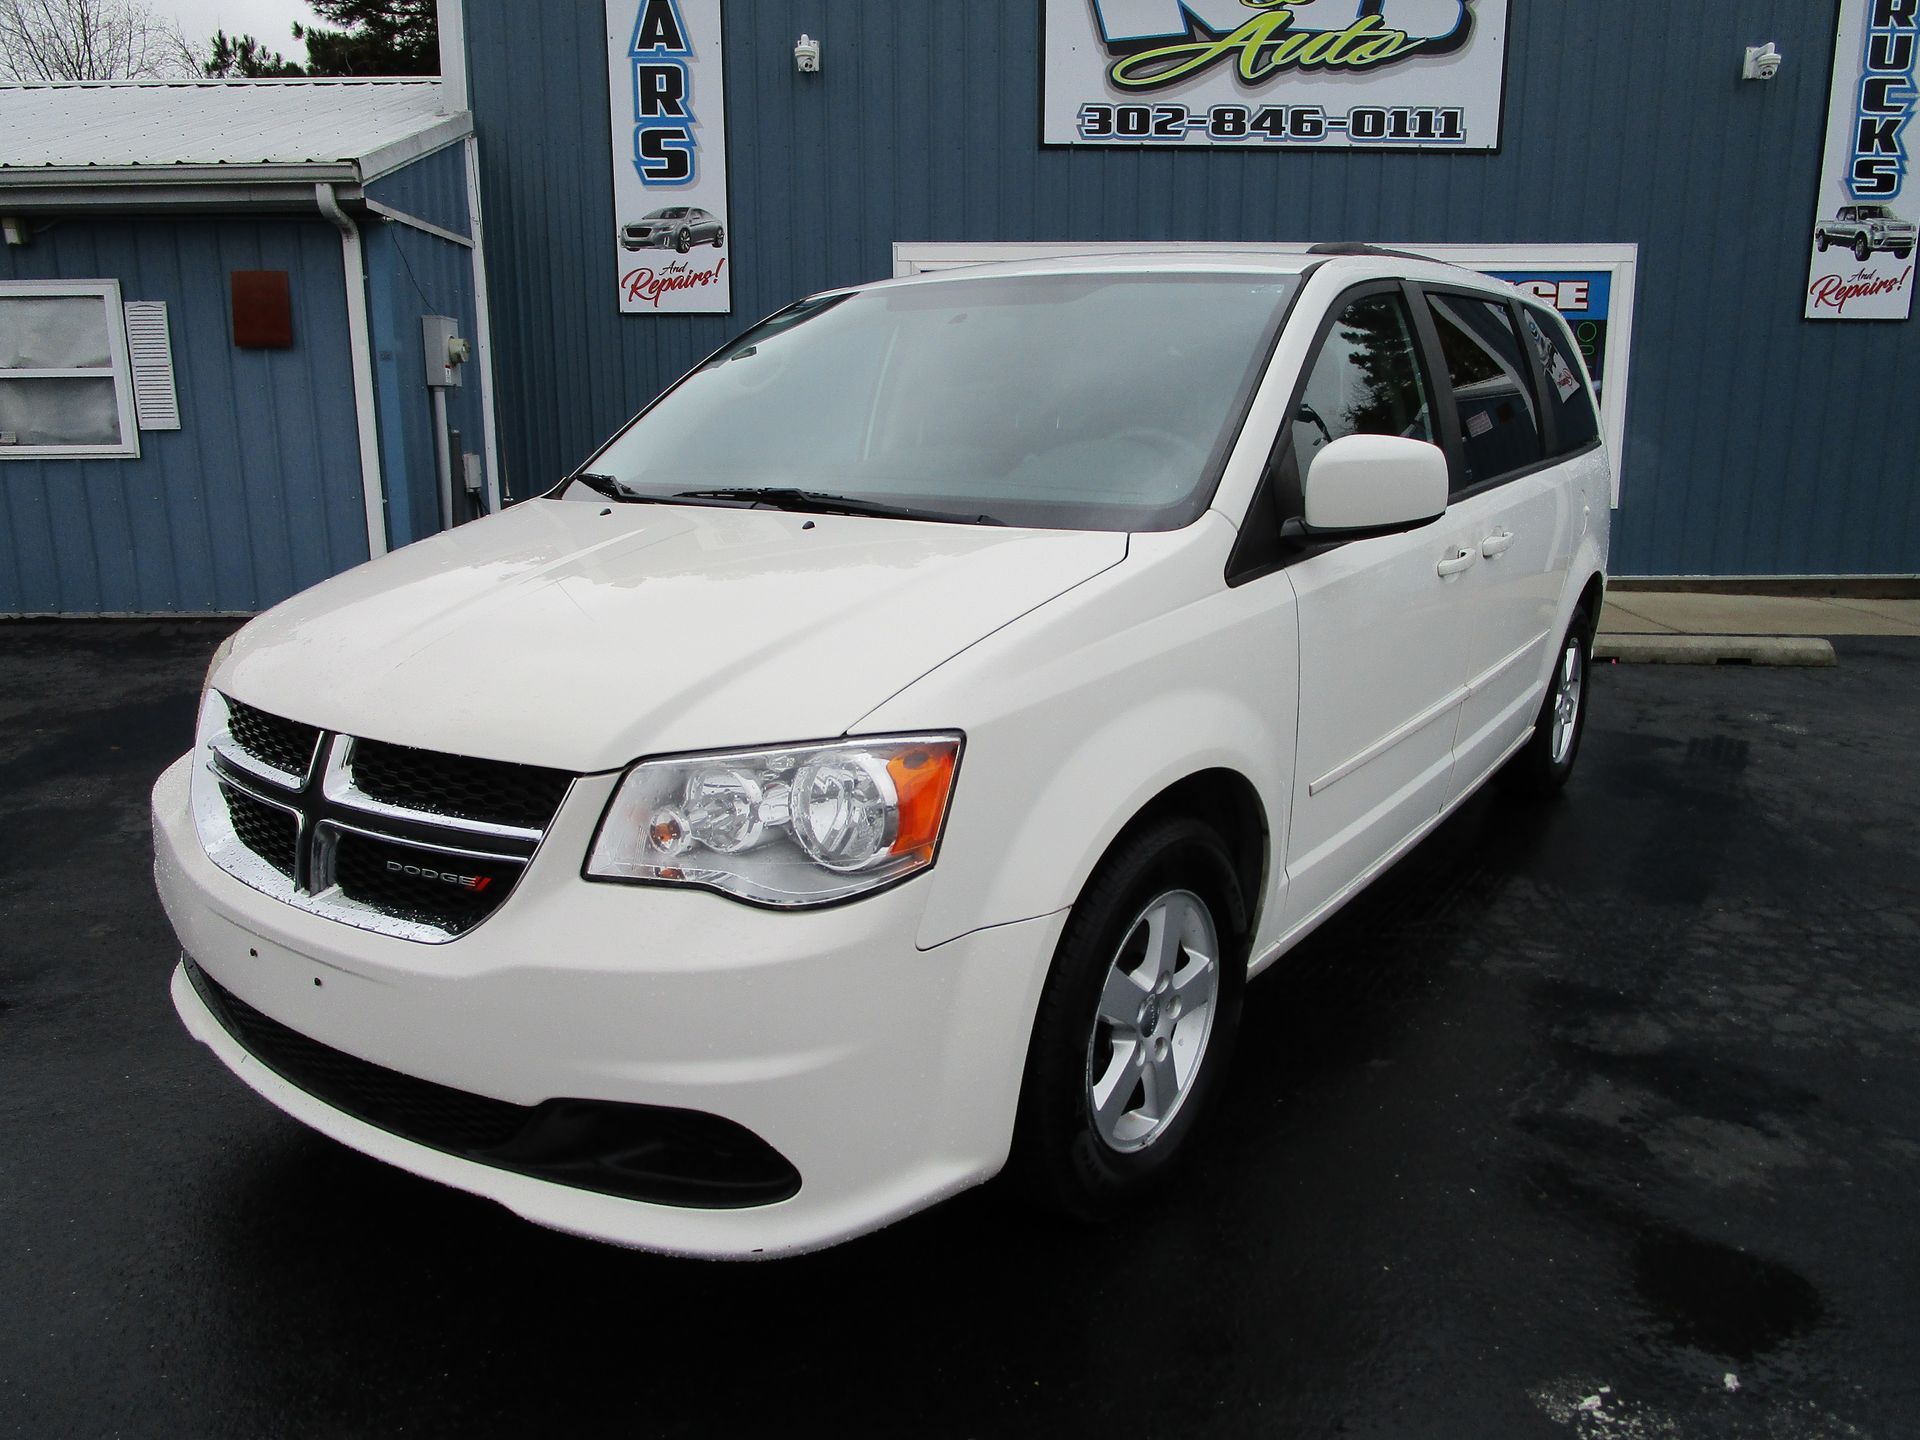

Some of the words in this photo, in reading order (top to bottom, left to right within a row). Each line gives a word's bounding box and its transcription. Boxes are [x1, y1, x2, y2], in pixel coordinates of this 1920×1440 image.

[1111, 9, 1427, 86] Auto
[1078, 104, 1466, 142] 302-846-0111
[621, 258, 725, 307] Repairs!
[659, 260, 688, 276] And
[1846, 267, 1876, 283] And
[1810, 266, 1911, 313] Repairs!
[386, 860, 476, 887] DODGE
